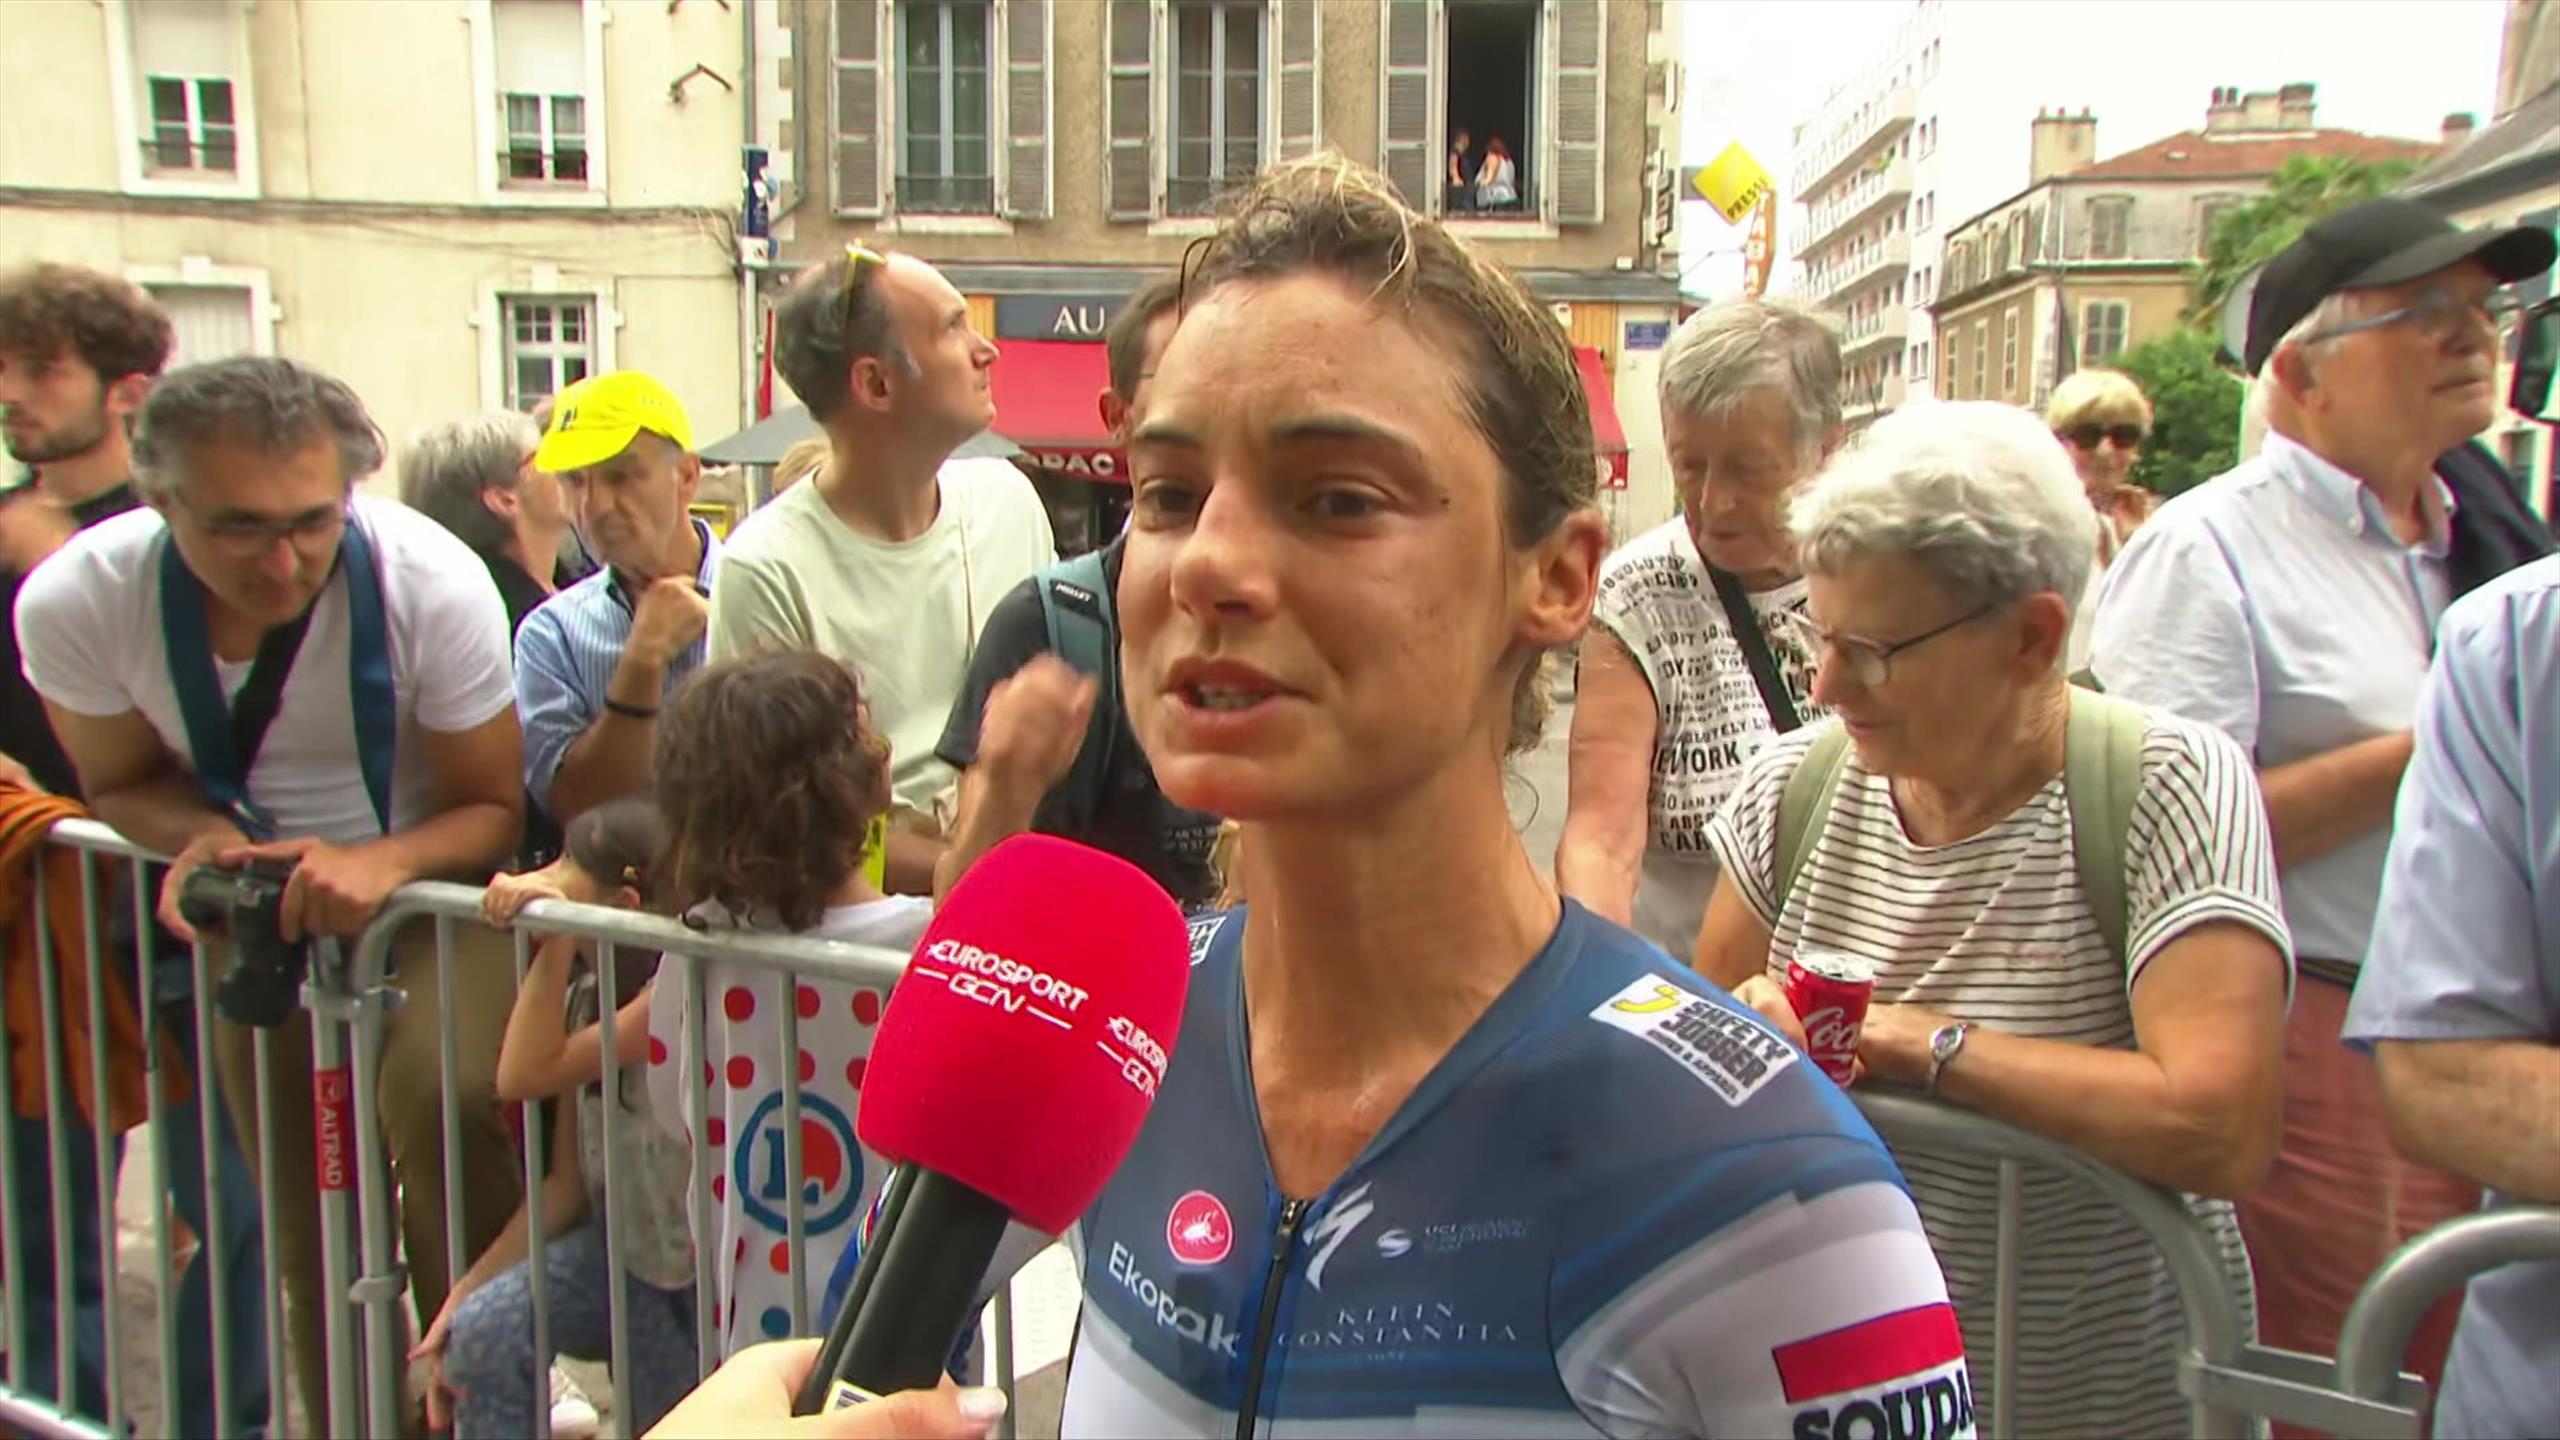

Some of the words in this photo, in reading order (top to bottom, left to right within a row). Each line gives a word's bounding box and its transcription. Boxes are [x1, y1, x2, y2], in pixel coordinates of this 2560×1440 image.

[1052, 304, 1105, 335] AU
[929, 938, 1089, 1012] EUROSPORT
[948, 972, 1026, 1013] GCN
[1660, 1010, 1768, 1088] JOGGER
[1682, 999, 1791, 1062] SAFETY
[1107, 1240, 1238, 1358] Ekopak
